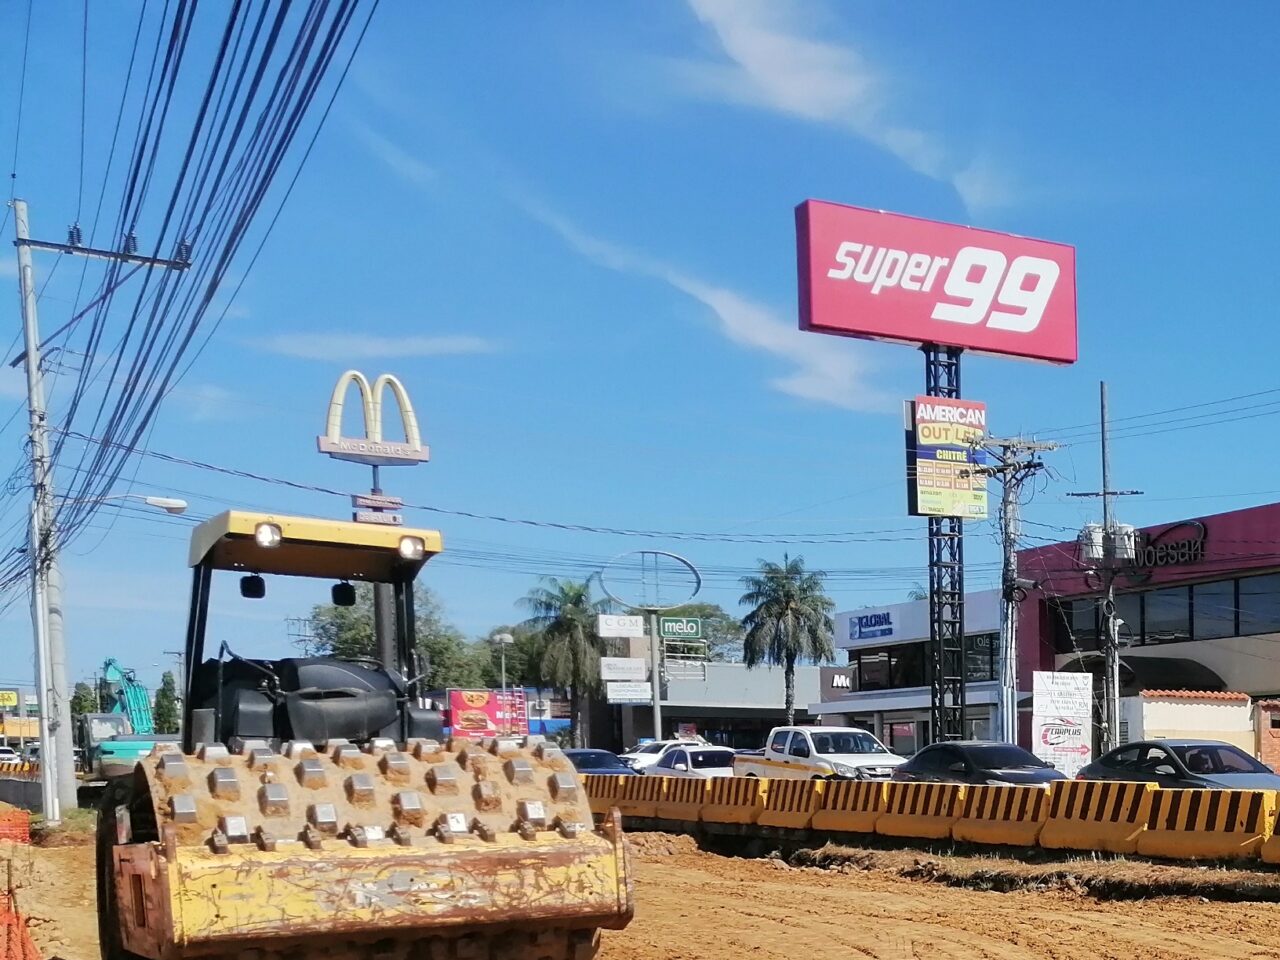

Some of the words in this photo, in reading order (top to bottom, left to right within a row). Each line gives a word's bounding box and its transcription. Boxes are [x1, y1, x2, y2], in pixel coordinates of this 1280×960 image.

[828, 241, 949, 295] super
[931, 246, 1060, 333] 99
[917, 403, 985, 425] AMERICAN
[936, 449, 967, 461] CHITRÉ
[664, 619, 697, 633] melo
[860, 612, 893, 629] GLOBAL
